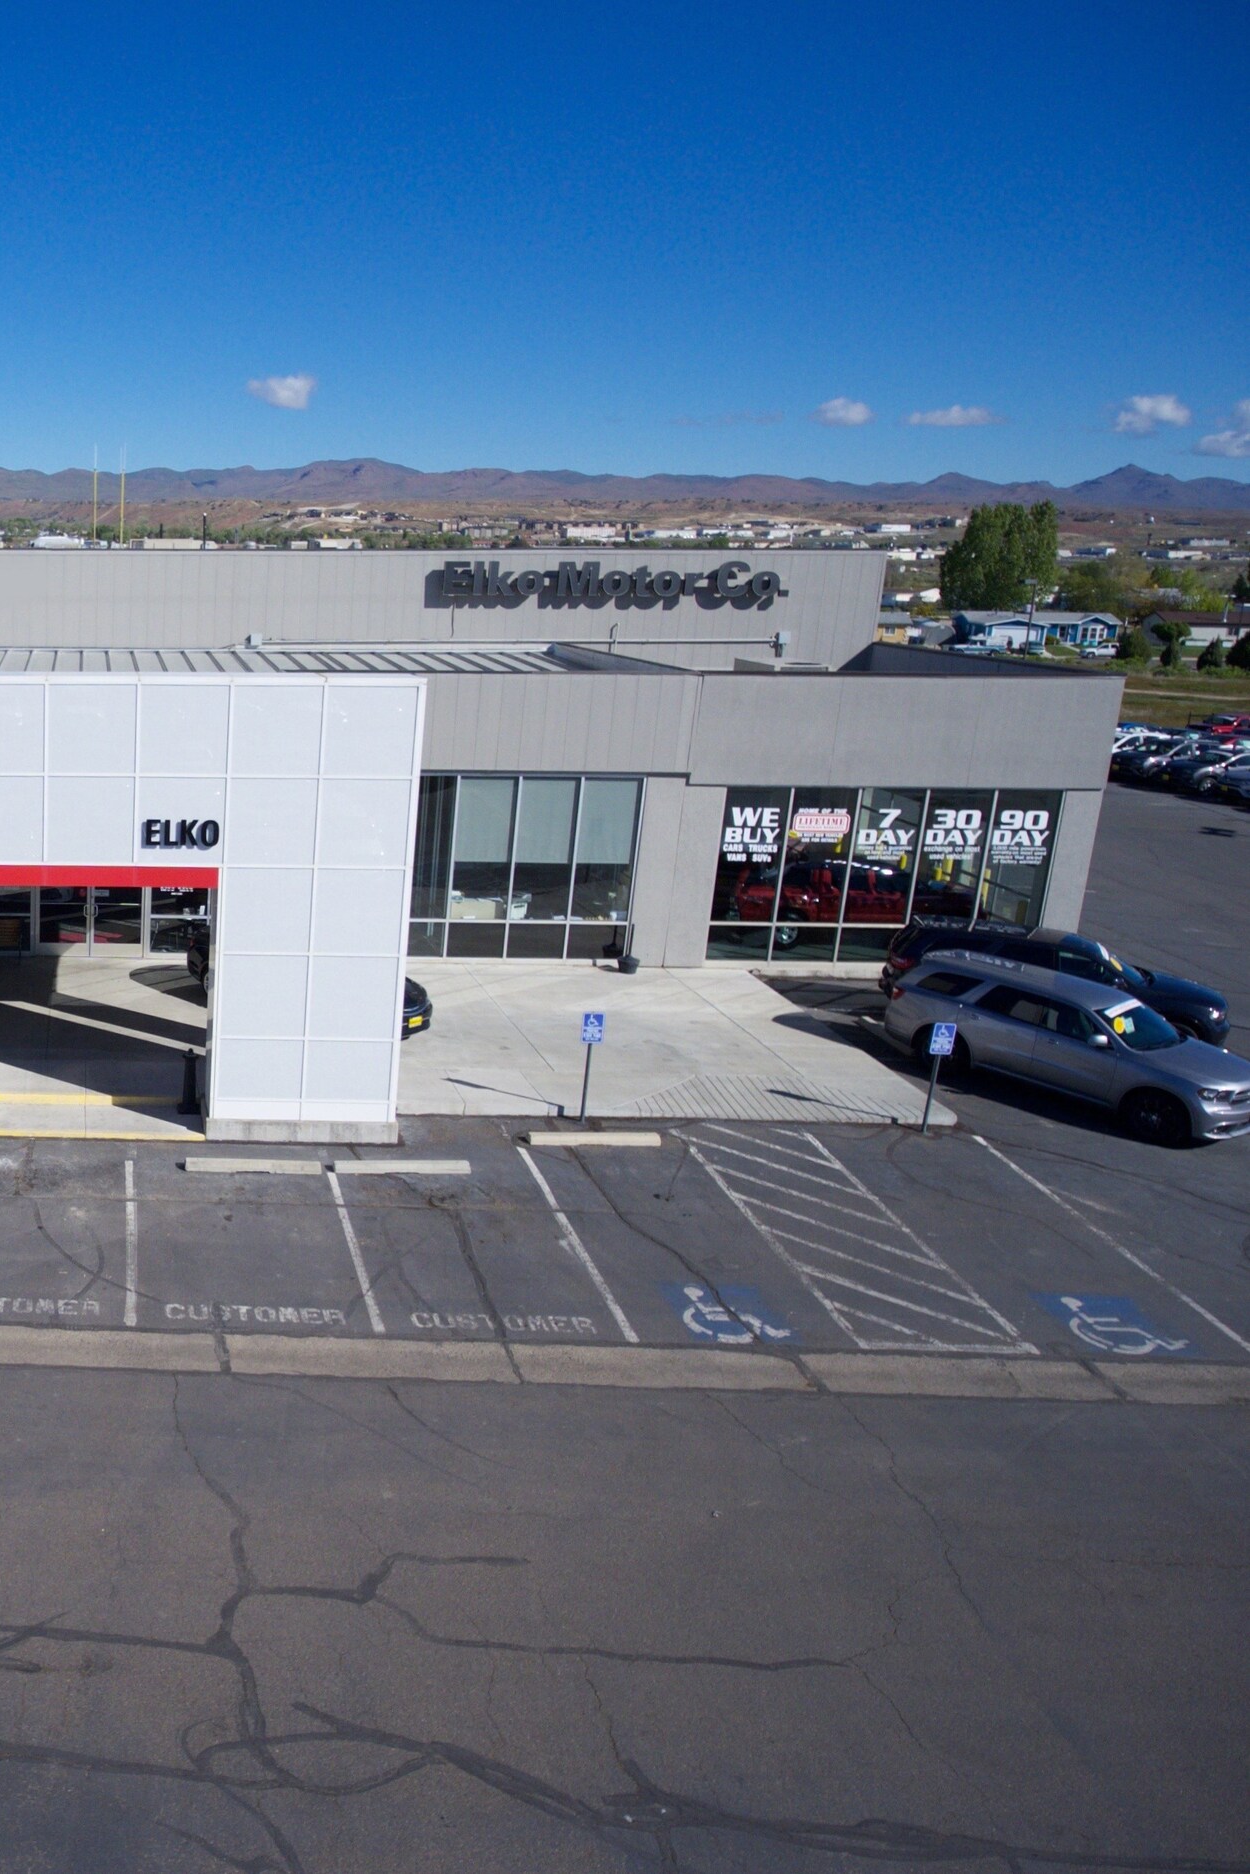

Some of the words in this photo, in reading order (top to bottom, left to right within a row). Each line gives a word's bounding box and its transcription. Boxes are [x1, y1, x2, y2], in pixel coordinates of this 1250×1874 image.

[442, 561, 545, 597] Elko
[556, 561, 704, 597] Motor
[716, 561, 789, 597] Co.
[732, 807, 780, 827] WE
[798, 817, 844, 825] LIFETIME
[879, 809, 902, 828] 7
[933, 809, 982, 829] 30
[1000, 810, 1049, 830] 90
[144, 819, 220, 847] ELKO
[724, 827, 780, 843] BUY
[857, 829, 915, 845] DAY
[925, 829, 982, 845] DAY
[992, 830, 1049, 846] DAY
[723, 844, 743, 852] CARS
[749, 844, 778, 853] TRUCKS
[727, 853, 747, 862] VANS
[164, 1303, 346, 1325] CUSTOMER
[410, 1312, 597, 1334] CUSTOMER
